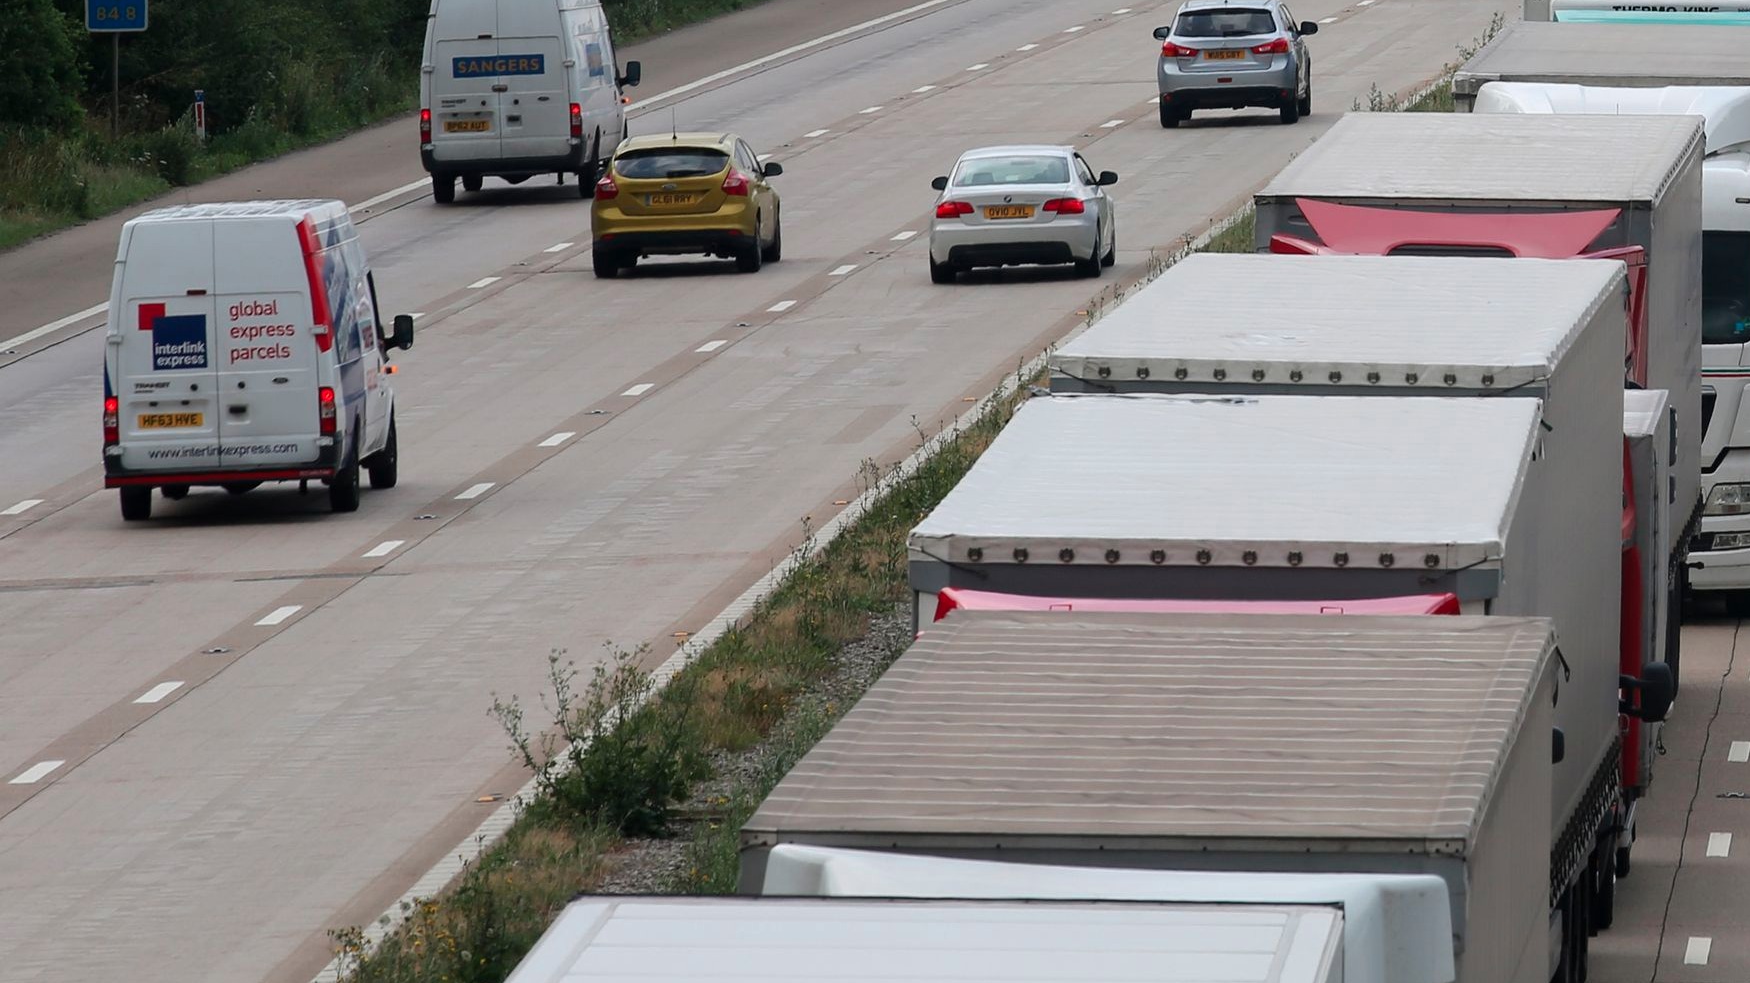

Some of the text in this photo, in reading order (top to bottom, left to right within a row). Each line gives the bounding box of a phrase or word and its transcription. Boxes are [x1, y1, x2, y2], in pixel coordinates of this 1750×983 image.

[457, 58, 540, 73] SANGERS
[229, 300, 278, 321] global
[230, 324, 296, 342] express
[155, 341, 206, 355] interlink
[230, 343, 291, 364] parcels
[156, 353, 205, 368] express
[142, 412, 198, 427] HF63 HVE
[148, 443, 298, 460] www.interlinkexpress.com
